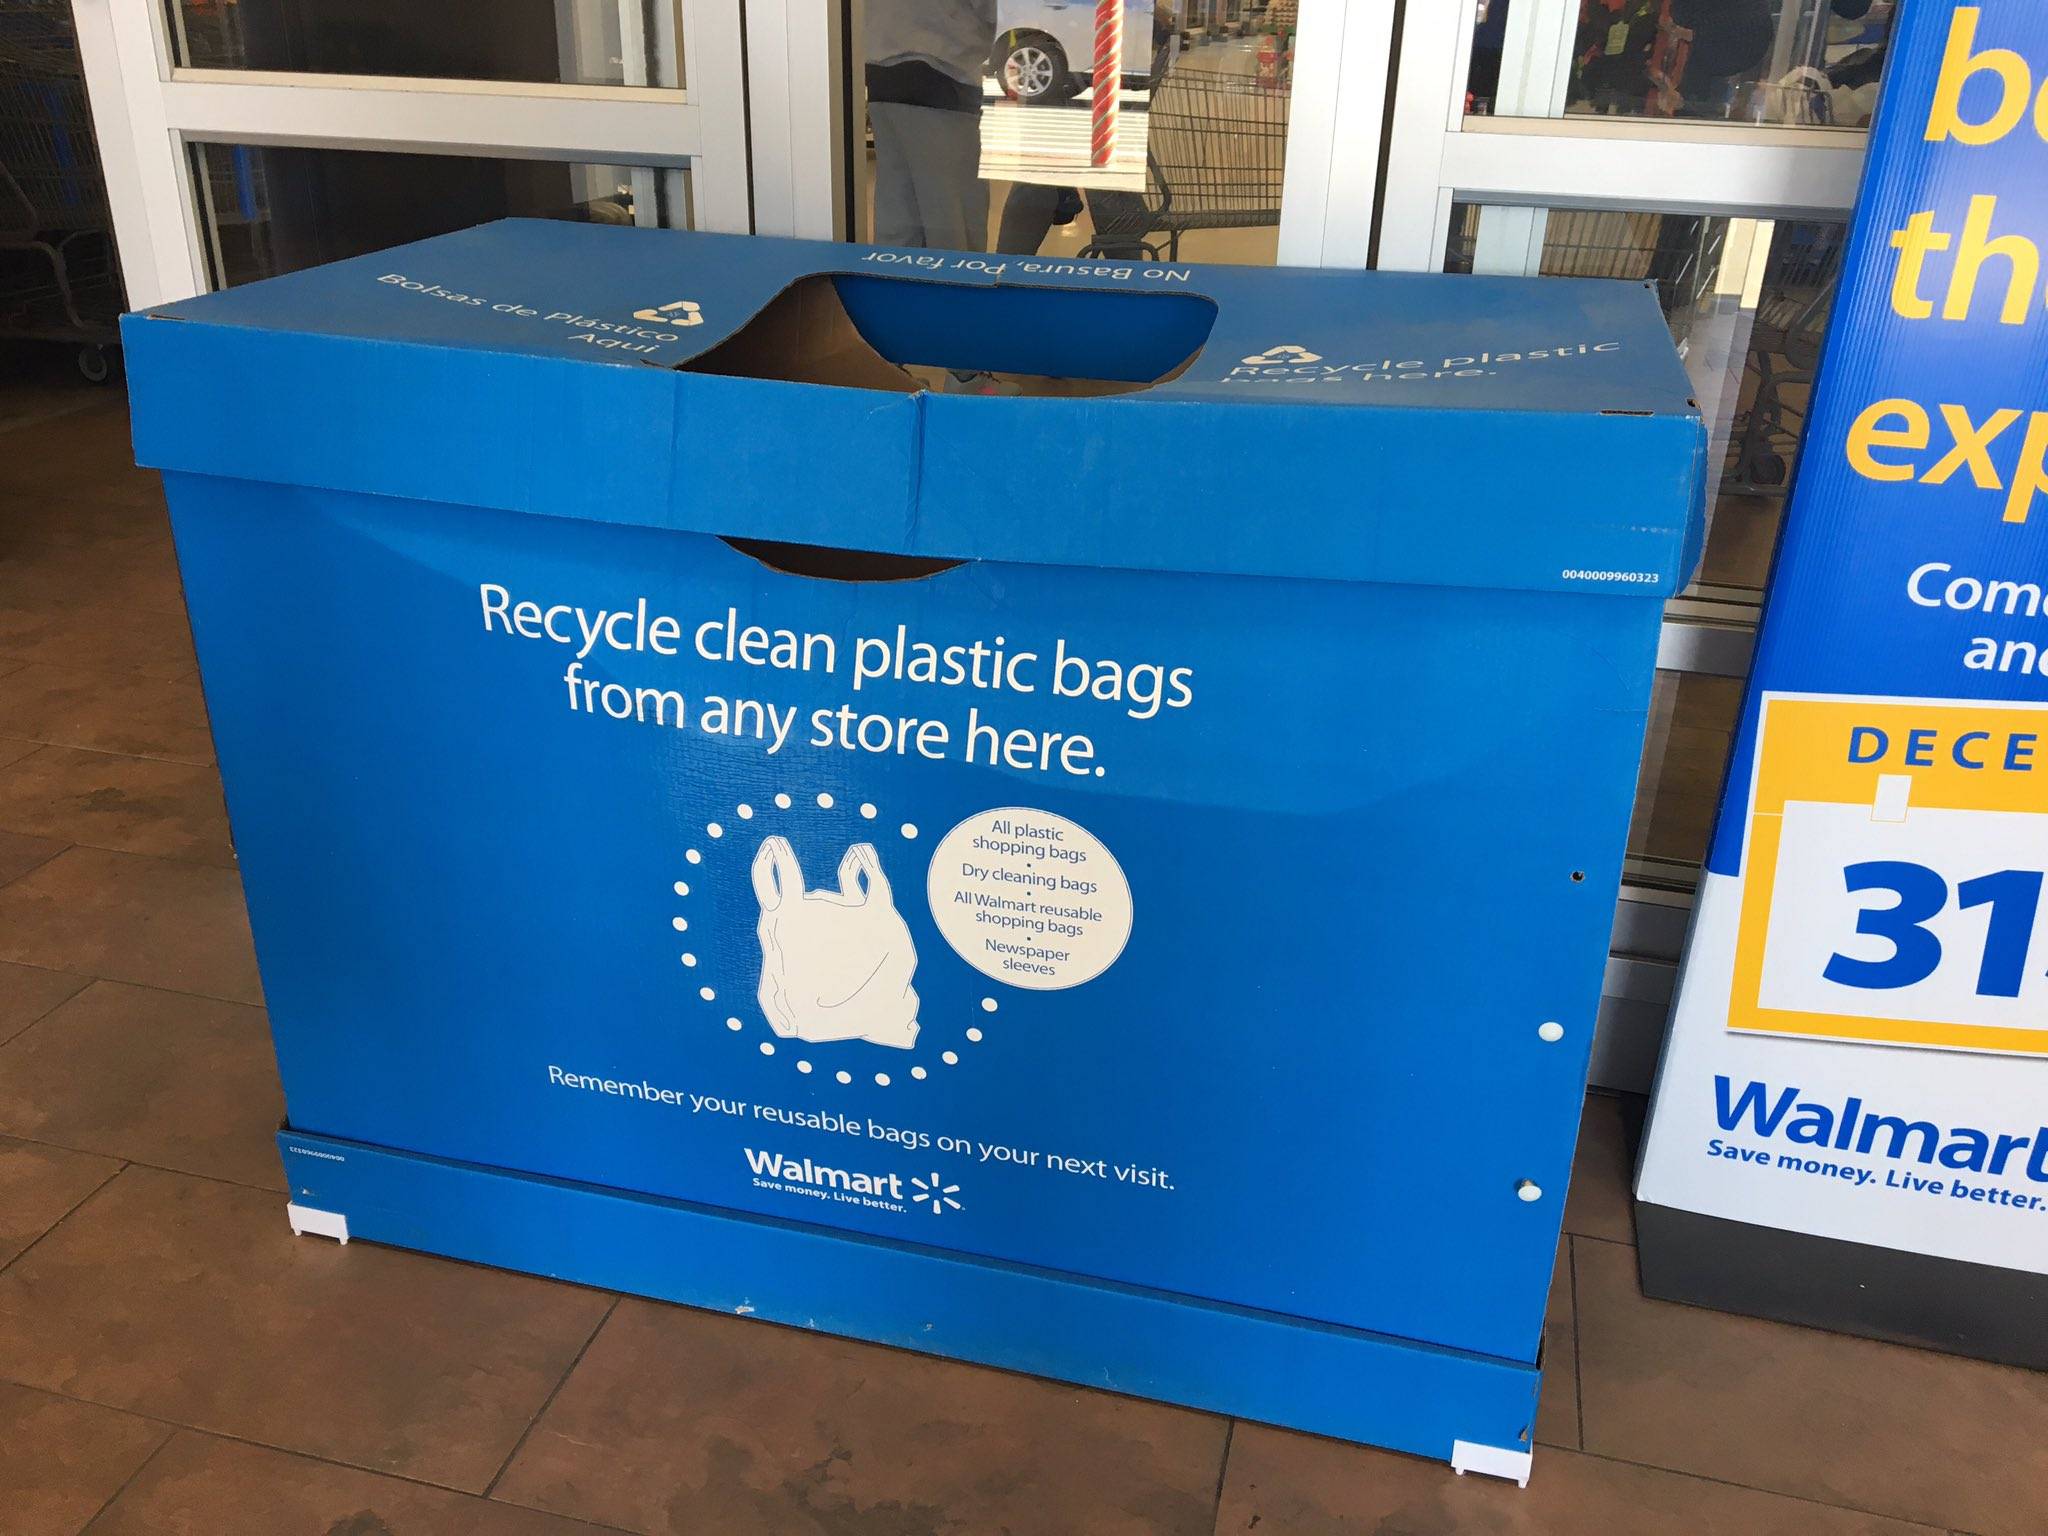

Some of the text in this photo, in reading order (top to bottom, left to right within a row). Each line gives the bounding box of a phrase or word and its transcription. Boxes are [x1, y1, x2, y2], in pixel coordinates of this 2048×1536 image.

[861, 252, 1191, 282] No Basura, Por favor
[1891, 196, 2048, 324] th
[377, 273, 487, 306] Bolsas
[492, 303, 537, 317] de
[543, 312, 678, 341] Plástico
[1230, 342, 1620, 376] Recycle plastic
[1362, 368, 1497, 382] here.
[1562, 569, 1660, 584] 0040009960323
[1907, 562, 2048, 617] Com
[480, 583, 1193, 720] Recycle clean plastic bags
[563, 662, 1105, 777] from any store here.
[1848, 726, 2038, 771] DECE
[991, 820, 1064, 842] All plastic
[972, 835, 1087, 864] shopping bags
[962, 863, 1097, 895] Dry cleaning bags
[954, 890, 1102, 922] All Walmart reusable
[975, 909, 1084, 938] shopping bags
[1822, 860, 2048, 998] 31
[985, 938, 1070, 962] Newspaper
[1002, 957, 1056, 976] sleeves
[548, 1065, 1174, 1190] Remember your reusable bags on your next visit.
[1714, 1074, 2048, 1183] Walmart
[744, 1148, 903, 1200] Walmart
[1706, 1139, 2047, 1212] Save money. Live better.
[753, 1177, 907, 1213] Save money. Live better.
